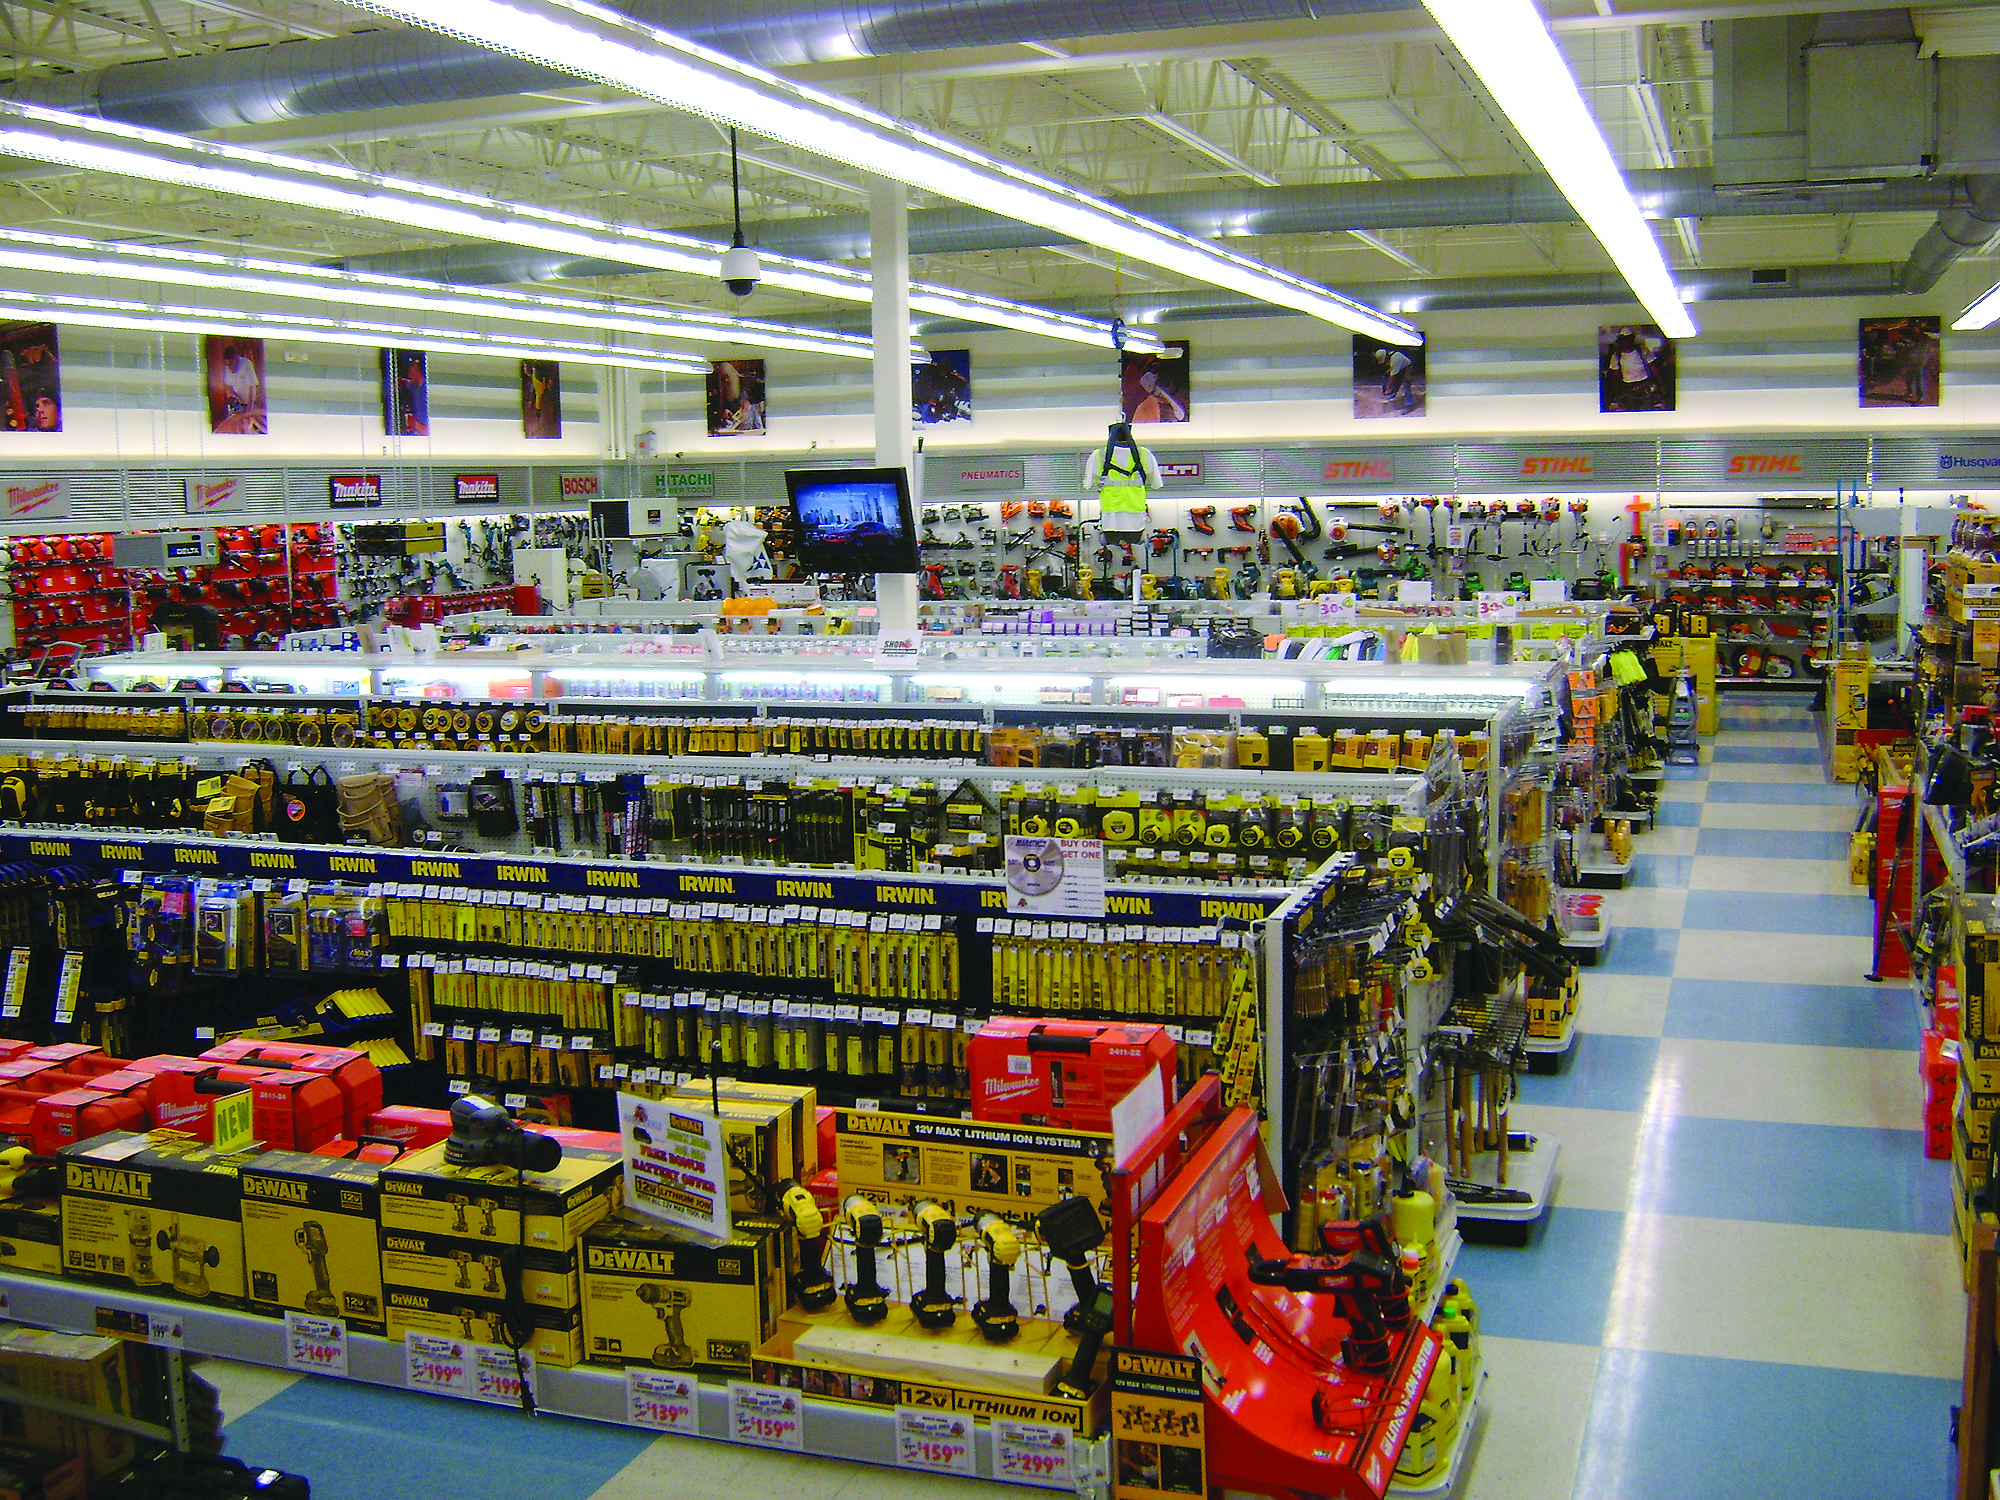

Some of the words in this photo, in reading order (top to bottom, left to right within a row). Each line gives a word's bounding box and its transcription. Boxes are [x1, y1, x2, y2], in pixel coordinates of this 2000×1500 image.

[1323, 461, 1393, 479] STIHL
[1520, 457, 1593, 474] STIHL
[1728, 455, 1803, 473] STIHL
[655, 473, 712, 487] HITACHI
[961, 469, 1020, 480] PNEUMATICS
[563, 477, 598, 495] BOSCH
[175, 547, 200, 555] DELTA
[30, 841, 72, 857] IRWIN
[101, 844, 144, 861] IRWIN
[1061, 840, 1079, 848] BUY
[1082, 840, 1101, 848] ONE
[174, 848, 219, 864] IRWIN
[250, 852, 297, 869] IRWIN
[1061, 850, 1079, 858] GET
[1081, 851, 1101, 859] ONE
[329, 856, 377, 873] IRWIN
[412, 860, 462, 878] IRWIN
[497, 865, 549, 883] IRWIN
[586, 870, 640, 889] IRWIN
[679, 875, 736, 893] IRWIN
[776, 880, 834, 899] IRWIN
[876, 886, 937, 904] IRWIN
[1200, 900, 1264, 919] IRWIN
[983, 1076, 1040, 1095] Milwaukee
[158, 1102, 208, 1121] Milwaukee
[217, 1097, 250, 1147] NEW
[848, 1116, 910, 1137] DEWALT
[914, 1125, 933, 1135] 12V
[935, 1126, 961, 1138] MAX
[965, 1130, 1010, 1143] LITHIUM
[1012, 1134, 1033, 1145] ION
[1035, 1137, 1081, 1149] SYSTEM
[66, 1165, 151, 1197] DEWALT
[243, 1177, 308, 1201] DEWALT
[385, 1180, 423, 1196] DEWALT
[660, 1187, 693, 1205] LITHIUM
[695, 1198, 711, 1211] ION
[387, 1237, 426, 1252] DEWALT
[589, 1248, 674, 1272] DEWALT
[391, 1293, 430, 1309] DEWALT
[1117, 1353, 1195, 1381] DEWALT
[956, 1396, 1038, 1421] LITHIUM
[1042, 1409, 1078, 1425] ION
